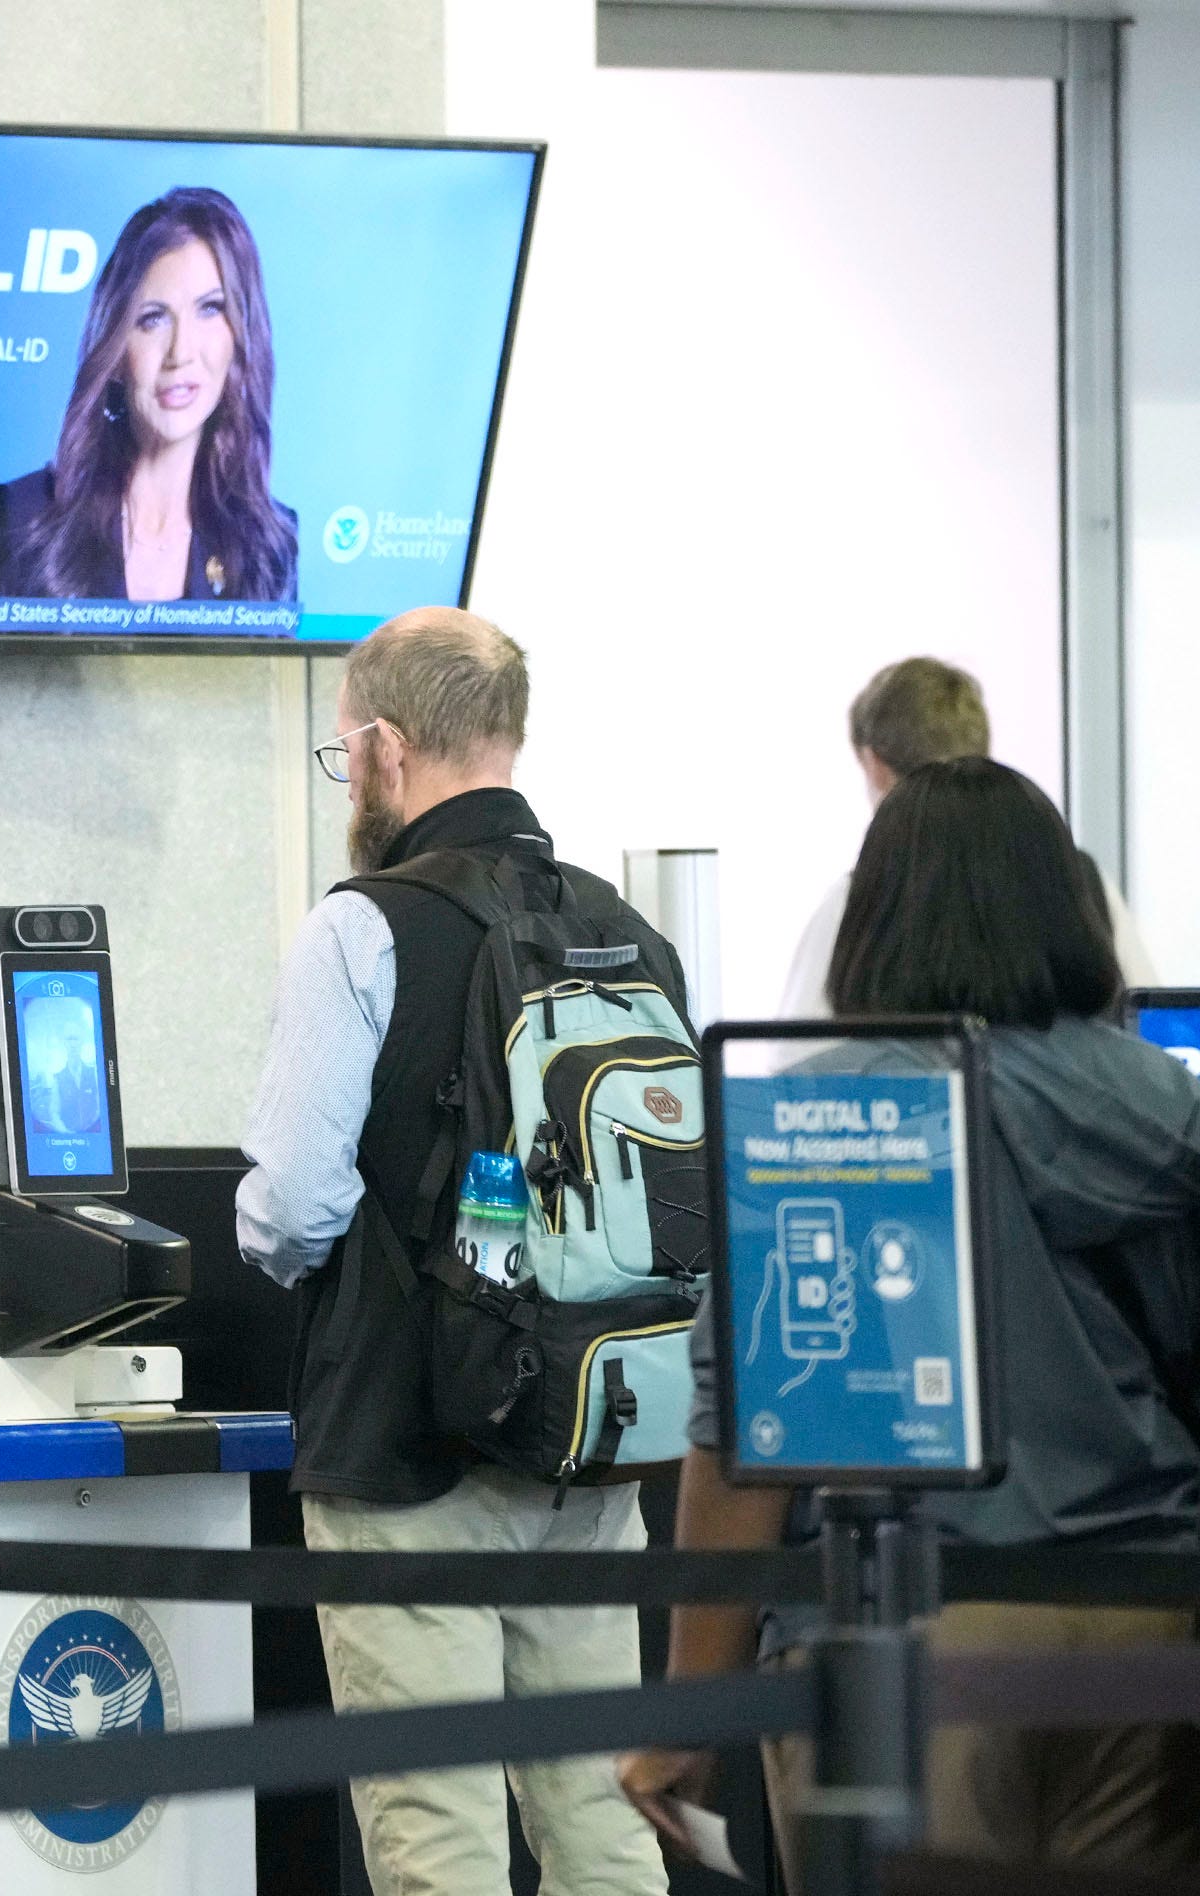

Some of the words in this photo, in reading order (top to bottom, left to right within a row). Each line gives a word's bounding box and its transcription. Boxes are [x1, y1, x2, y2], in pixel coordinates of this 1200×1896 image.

[20, 228, 99, 293] ID
[374, 511, 471, 535] Homelan
[371, 536, 452, 566] Security
[9, 602, 58, 623] States
[60, 603, 134, 628] Secretary
[133, 604, 154, 625] of
[152, 604, 234, 625] Homeland
[774, 1099, 869, 1133] DIGITAL
[870, 1099, 901, 1133] ID
[797, 1276, 828, 1308] ID
[129, 1606, 181, 1731] SECURIT
